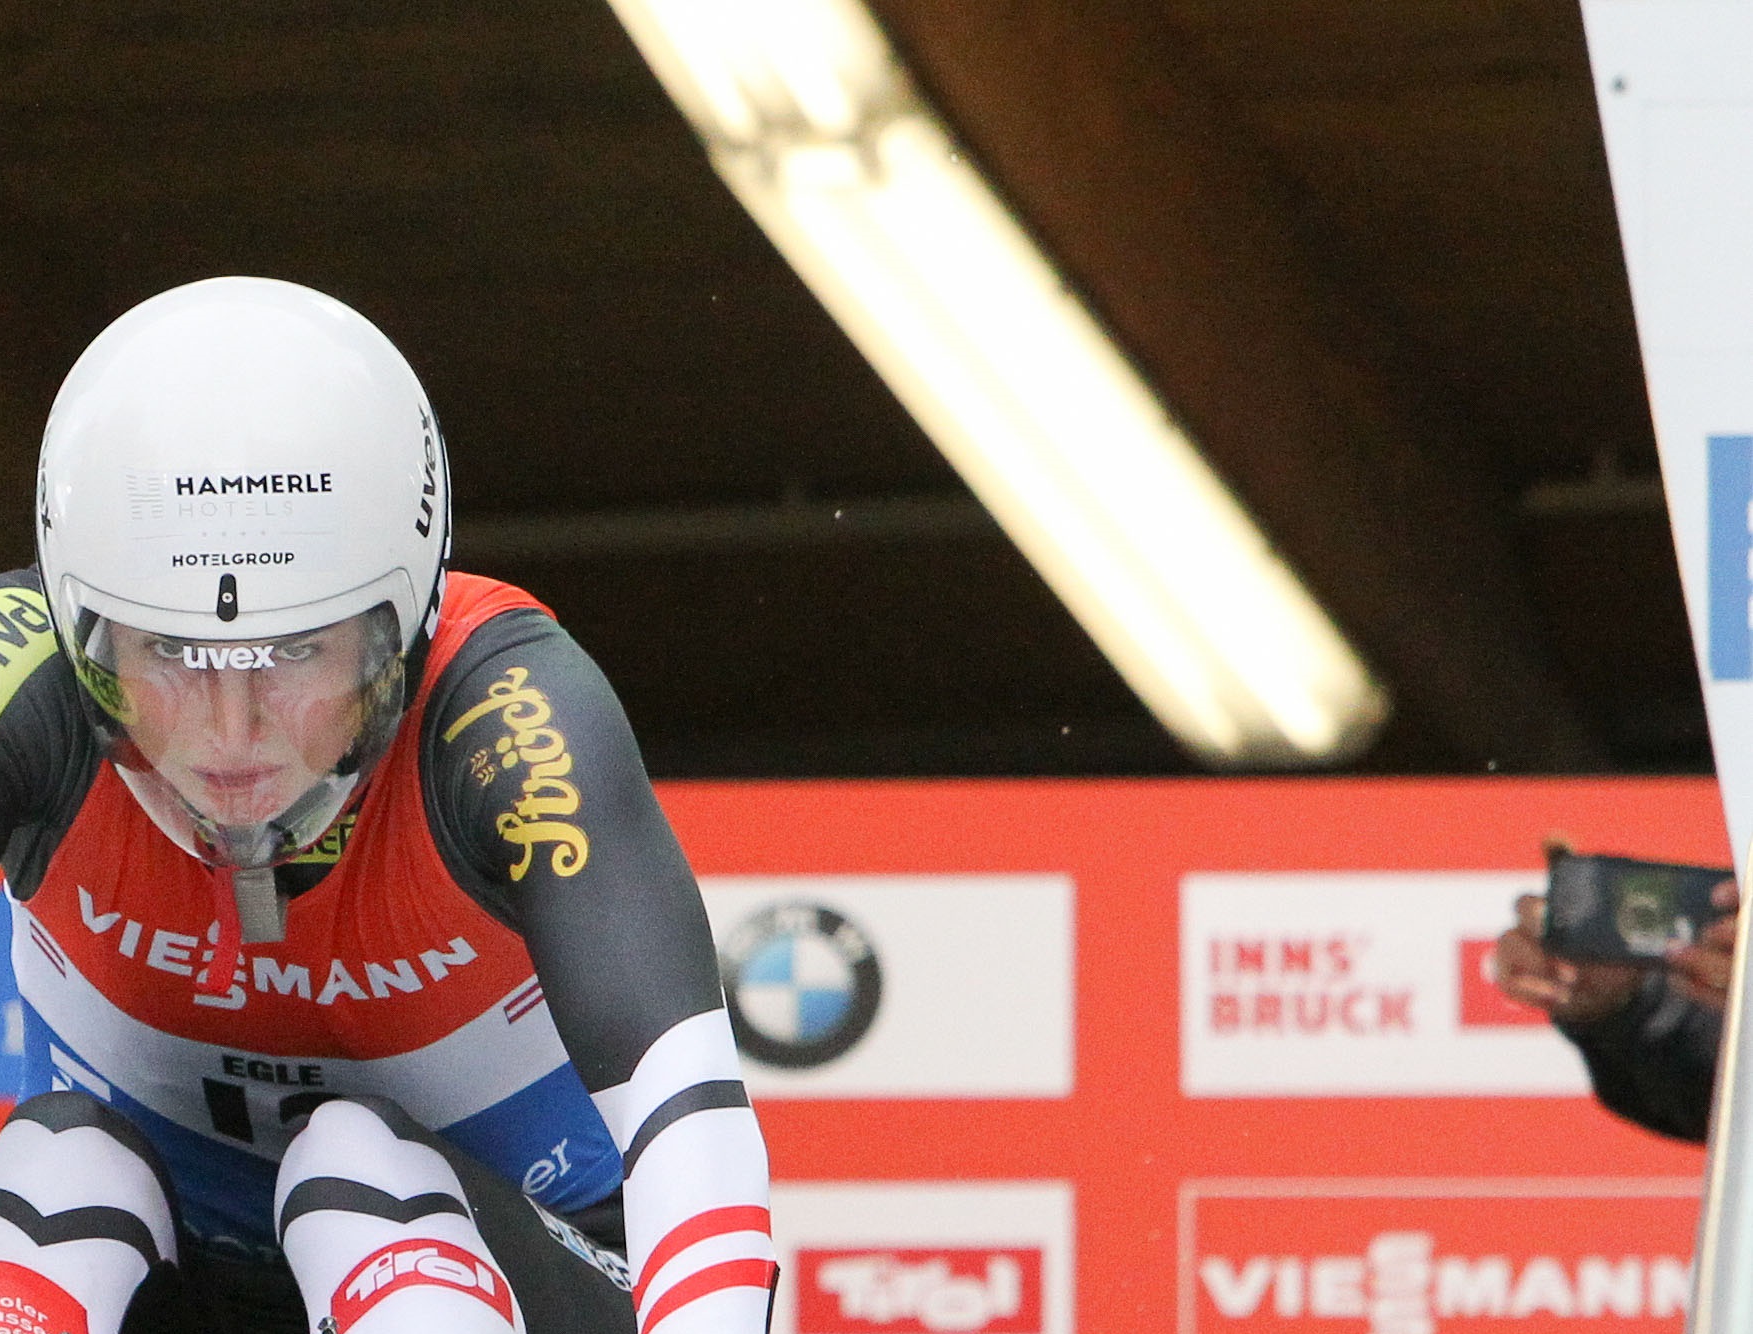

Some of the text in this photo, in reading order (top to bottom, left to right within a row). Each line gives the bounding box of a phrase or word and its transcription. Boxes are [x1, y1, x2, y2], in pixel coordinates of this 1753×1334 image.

[175, 473, 333, 496] HAMMERLE
[177, 501, 296, 518] HOTELS
[172, 552, 295, 568] HOTELGROUP
[182, 644, 277, 671] uvex
[1209, 993, 1415, 1034] BRUCK
[222, 1054, 326, 1087] EGLE
[345, 1246, 496, 1302] Tirol
[818, 1254, 1022, 1333] Tirol
